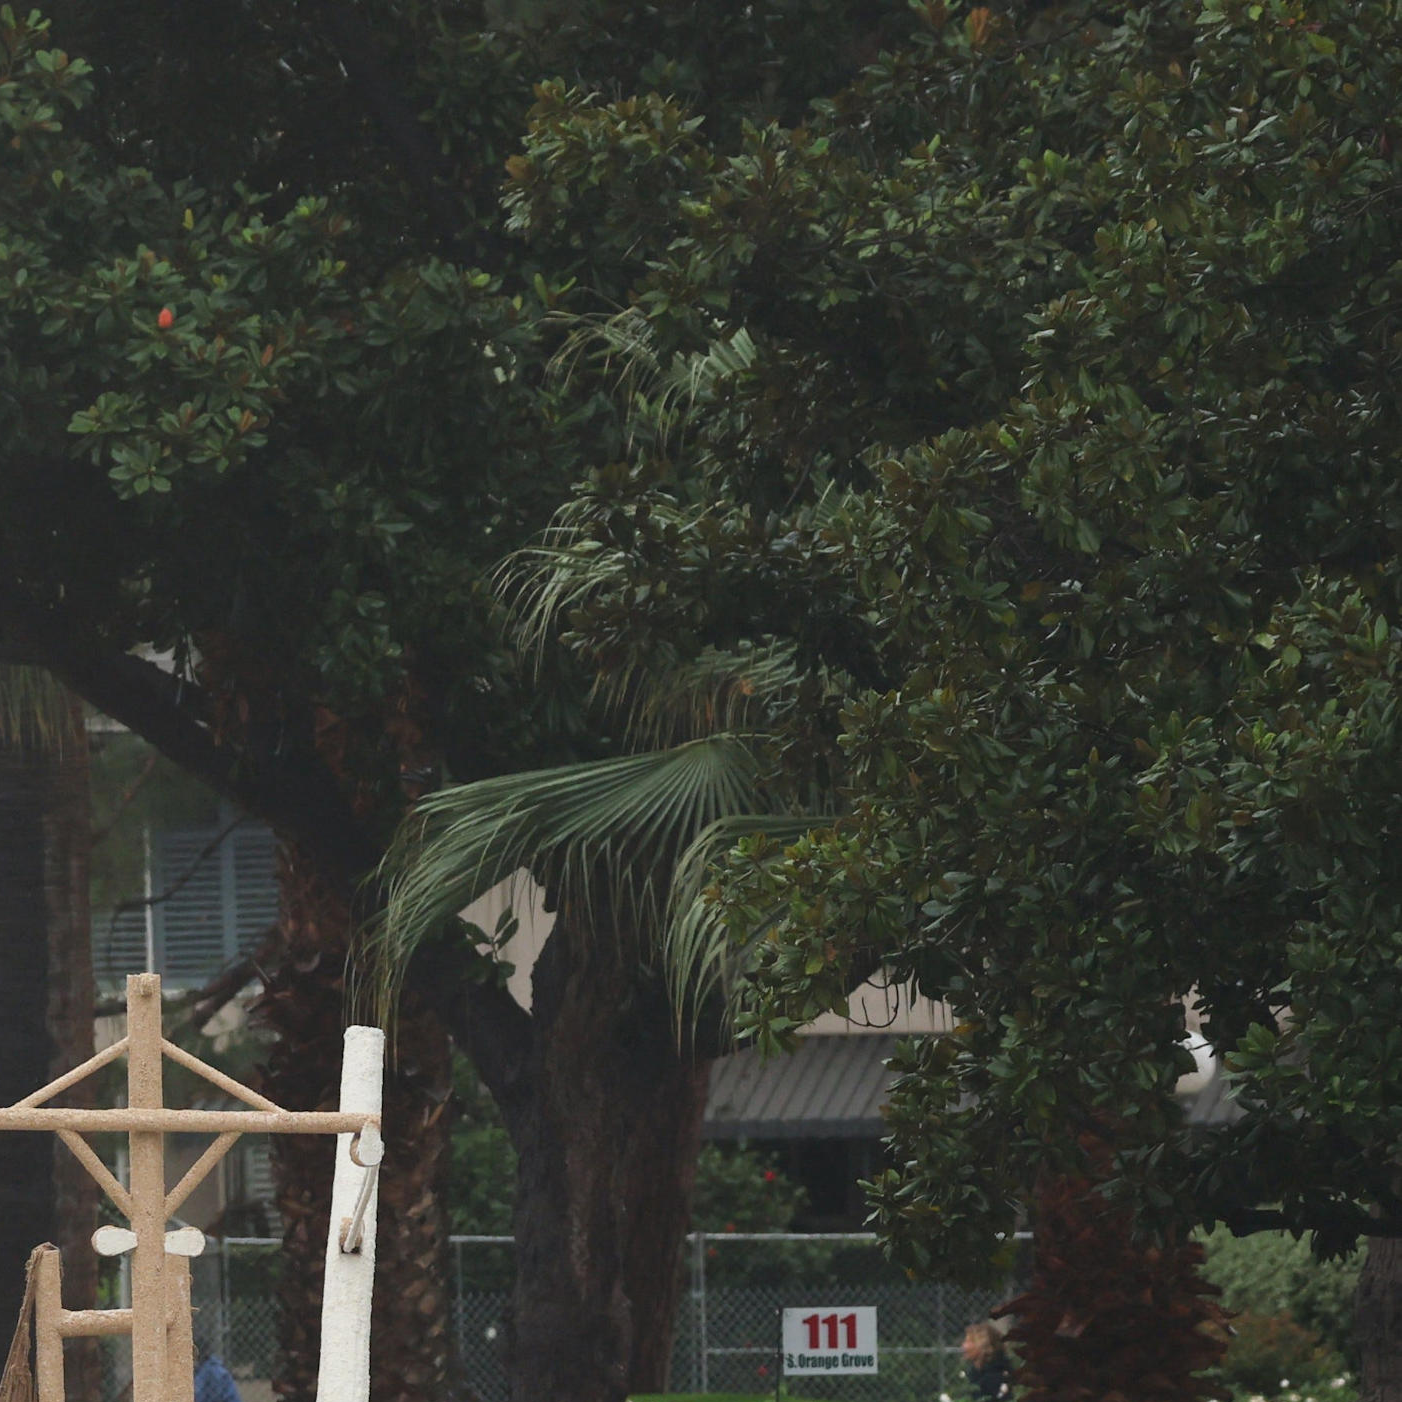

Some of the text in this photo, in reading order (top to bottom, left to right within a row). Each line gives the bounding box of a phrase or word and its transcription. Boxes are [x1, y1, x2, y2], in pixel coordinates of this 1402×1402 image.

[802, 1313, 857, 1349] 111
[798, 1353, 839, 1370] Orange
[841, 1352, 874, 1368] Grove
